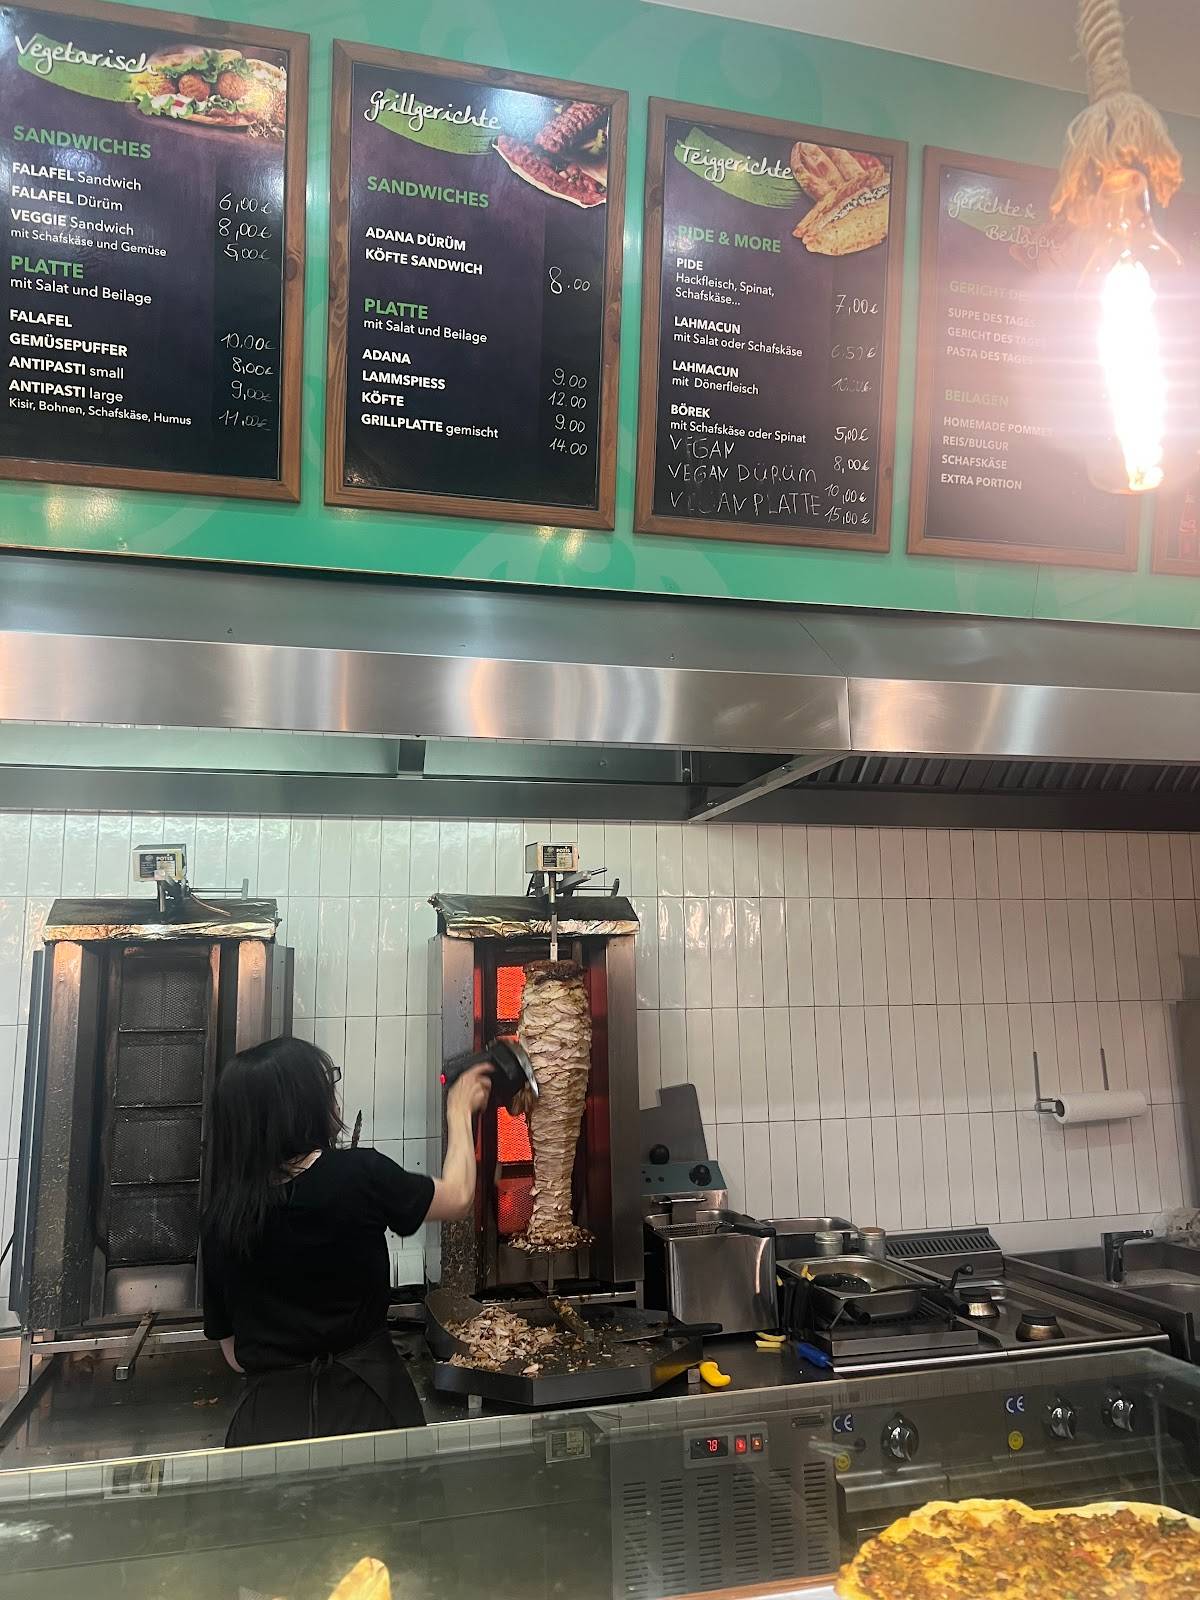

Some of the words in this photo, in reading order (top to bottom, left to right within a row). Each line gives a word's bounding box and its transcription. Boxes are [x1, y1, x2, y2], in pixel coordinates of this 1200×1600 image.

[15, 35, 155, 75] Vegetarisch
[364, 91, 501, 131] Grillgerichte
[13, 125, 152, 159] SANDWICHES
[680, 142, 794, 183] Teiggerichte
[12, 162, 75, 182] FALAFEL
[77, 171, 142, 191] Sandwich
[11, 185, 74, 205] FALAFEL
[77, 194, 123, 211] Dürüm
[367, 176, 489, 208] SANDWICHES
[10, 209, 67, 227] VEGGIE
[70, 217, 134, 236] Sandwich
[10, 229, 29, 239] mit
[32, 229, 93, 248] Schafskäse
[96, 238, 118, 250] und
[121, 242, 167, 257] Gemüse
[366, 227, 414, 245] ADANA
[417, 233, 466, 251] DÜRÜM
[678, 225, 714, 243] PIDE
[719, 232, 730, 245] &
[735, 234, 781, 253] MORE
[985, 225, 1057, 258] Beilagen
[11, 256, 84, 279] PLATTE
[365, 248, 408, 265] KÖFTE
[411, 254, 483, 275] SANDWICH
[677, 258, 703, 271] PIDE
[10, 277, 32, 290] mit
[36, 279, 69, 294] Salat
[72, 285, 98, 297] und
[102, 287, 152, 305] Beilage
[549, 266, 590, 294] 8.00
[676, 273, 737, 291] Hackfleisch,
[740, 282, 775, 297] Spinat,
[950, 280, 1010, 299] GERICHT
[675, 287, 741, 306] Schafskäse...
[9, 309, 72, 328] FALAFEL
[364, 298, 428, 319] PLATTE
[948, 307, 980, 321] SUPPE
[983, 313, 1002, 323] DES
[363, 318, 383, 330] mit
[386, 320, 415, 334] Salat
[418, 324, 440, 337] und
[444, 327, 487, 344] Beilage
[674, 316, 741, 335] LAHMACUN
[9, 333, 128, 357] GEMÜSEPUFFER
[674, 332, 691, 343] mit
[693, 334, 719, 347] Salat
[721, 337, 746, 350] oder
[748, 341, 803, 357] Schafskäse
[947, 327, 991, 341] GERICHT
[993, 333, 1013, 343] DES
[1014, 336, 1044, 347] TAGE
[362, 349, 411, 365] ADANA
[947, 345, 978, 360] PASTA
[980, 351, 1000, 361] DES
[9, 356, 86, 376] ANTIPASTI
[89, 366, 124, 380] small
[552, 368, 587, 389] 9.00
[672, 360, 739, 378] LAHMACUN
[9, 380, 86, 398] ANTIPASTI
[89, 387, 123, 402] large
[362, 370, 446, 390] LAMMSPIESS
[672, 377, 689, 387] mit
[694, 378, 759, 395] Dönerfleisch
[361, 390, 404, 407] KÖFTE
[548, 392, 586, 409] 12.00
[944, 389, 1009, 406] BEILAGEN
[9, 398, 36, 411] Kisir,
[38, 400, 86, 416] Bohnen,
[88, 406, 151, 423] Schafskäse,
[153, 412, 192, 426] Humus
[671, 403, 711, 419] BÖREK
[361, 413, 443, 433] GRILLPLATTE
[446, 424, 499, 439] gemischt
[554, 413, 585, 433] 9.00
[670, 420, 687, 431] mit
[689, 422, 746, 437] Schafskäse
[748, 428, 772, 440] oder
[774, 430, 806, 444] Spinat
[943, 416, 1005, 432] HOMEMADE
[549, 438, 587, 456] 14.00
[670, 434, 735, 459] VEGAN
[942, 435, 1009, 451] REIS/BULGUR
[941, 454, 1007, 470] SCHAFSKÄSE
[668, 464, 729, 483] VEGAN
[940, 473, 974, 486] EXTRA
[976, 475, 1022, 490] PORTION
[753, 492, 820, 516] PLATTE
